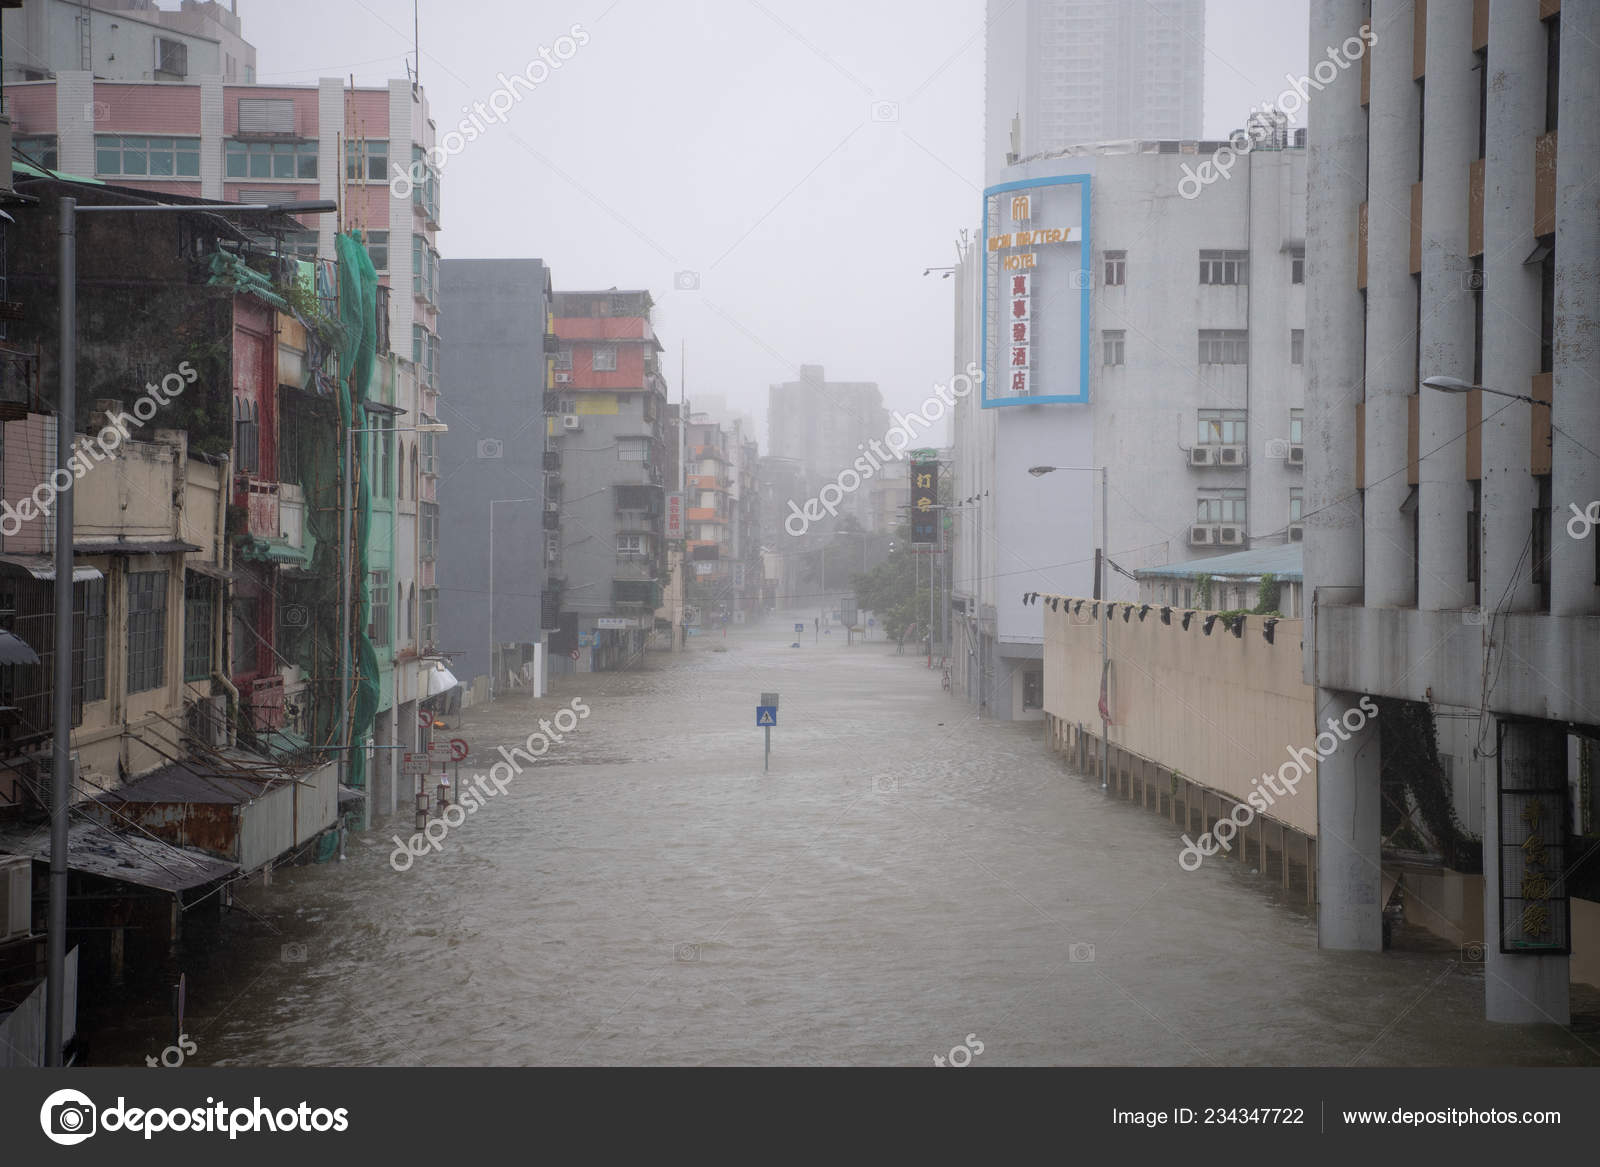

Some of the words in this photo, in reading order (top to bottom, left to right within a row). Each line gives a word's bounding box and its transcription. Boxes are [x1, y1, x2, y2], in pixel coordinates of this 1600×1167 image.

[1016, 228, 1071, 247] MASTERS
[1004, 253, 1037, 272] HOTEL
[1012, 275, 1027, 390] 萬事發酒店
